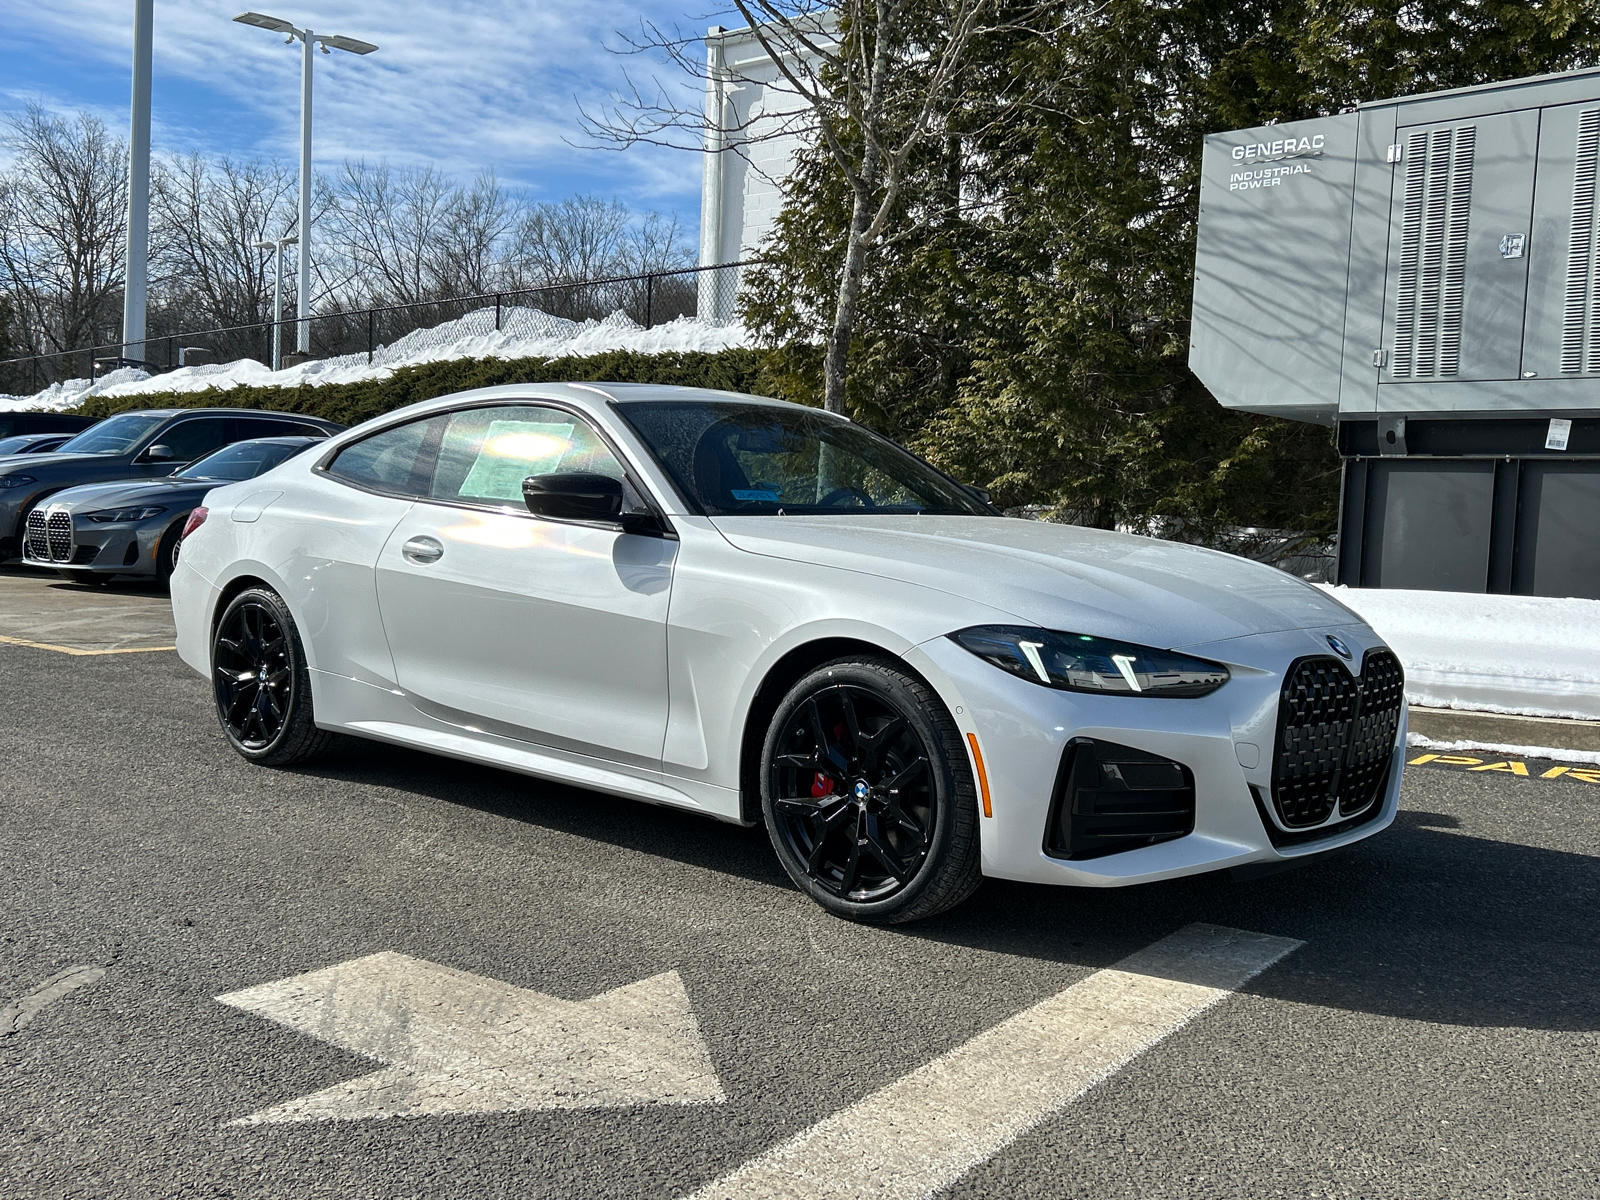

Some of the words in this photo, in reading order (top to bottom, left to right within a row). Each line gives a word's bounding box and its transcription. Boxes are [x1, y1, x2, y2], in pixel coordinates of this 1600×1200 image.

[1231, 134, 1325, 160] GENERAC
[1230, 164, 1312, 183] INDUSTRIAL
[1229, 177, 1281, 192] POWER
